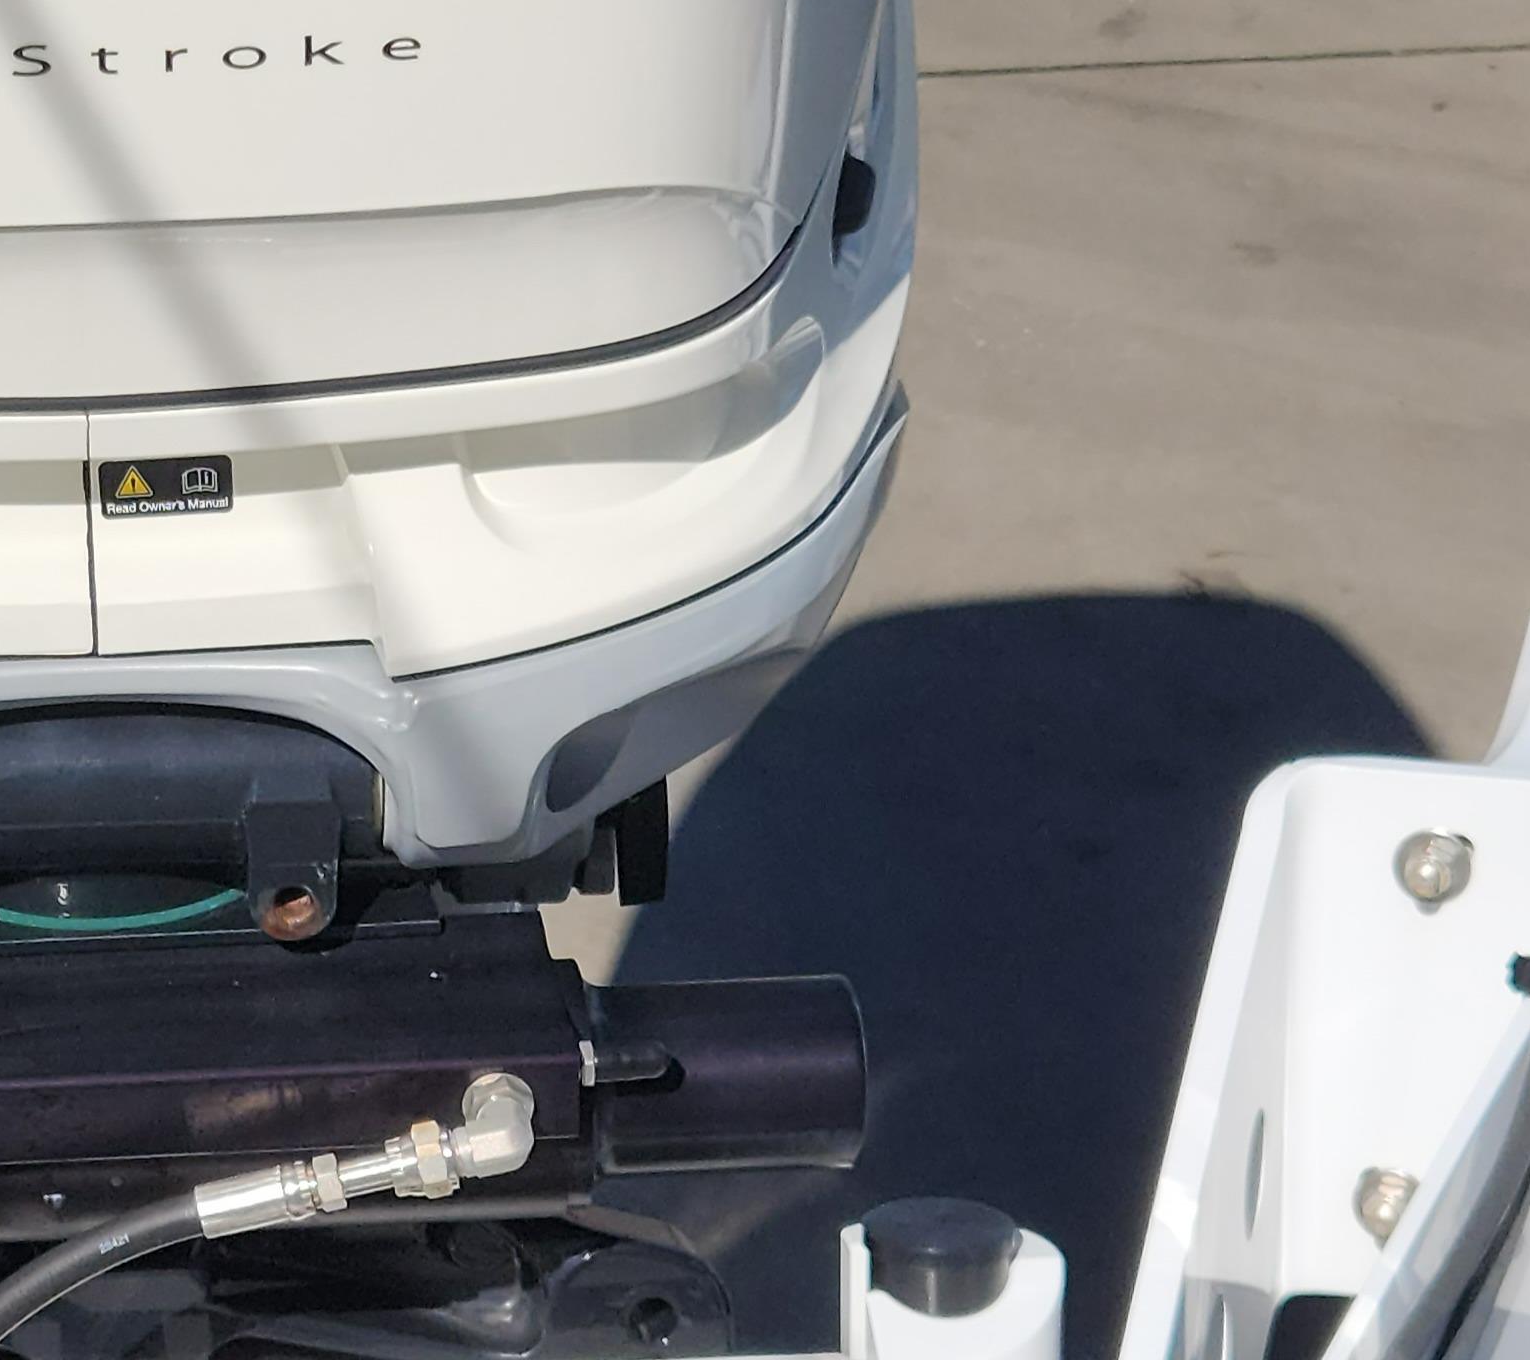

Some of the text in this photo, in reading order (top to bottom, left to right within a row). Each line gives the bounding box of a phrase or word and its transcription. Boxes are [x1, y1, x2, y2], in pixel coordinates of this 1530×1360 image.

[106, 496, 229, 516] Read Owner's Manual
